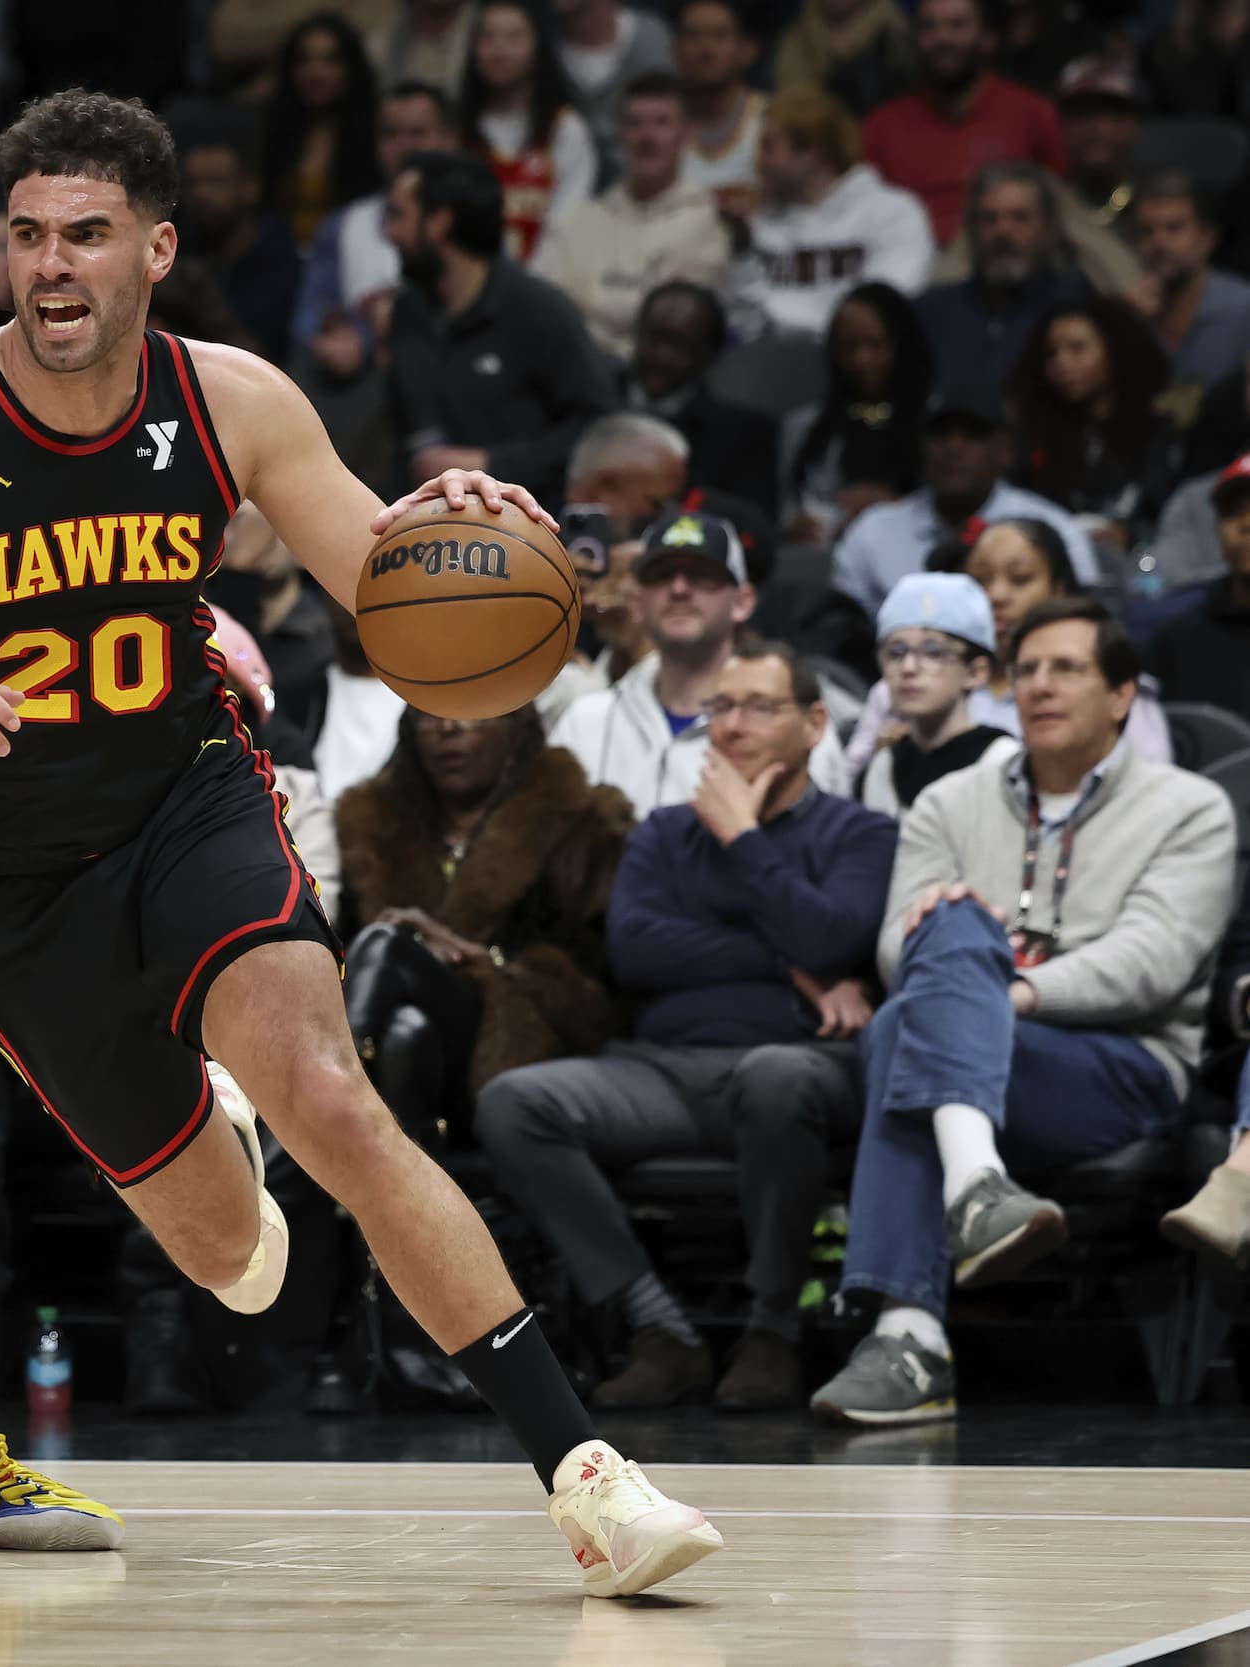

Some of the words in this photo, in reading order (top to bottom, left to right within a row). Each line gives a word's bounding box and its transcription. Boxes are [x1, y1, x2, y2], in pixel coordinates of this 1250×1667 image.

[136, 446, 152, 458] the
[145, 420, 179, 470] Y
[370, 538, 511, 581] Wilson
